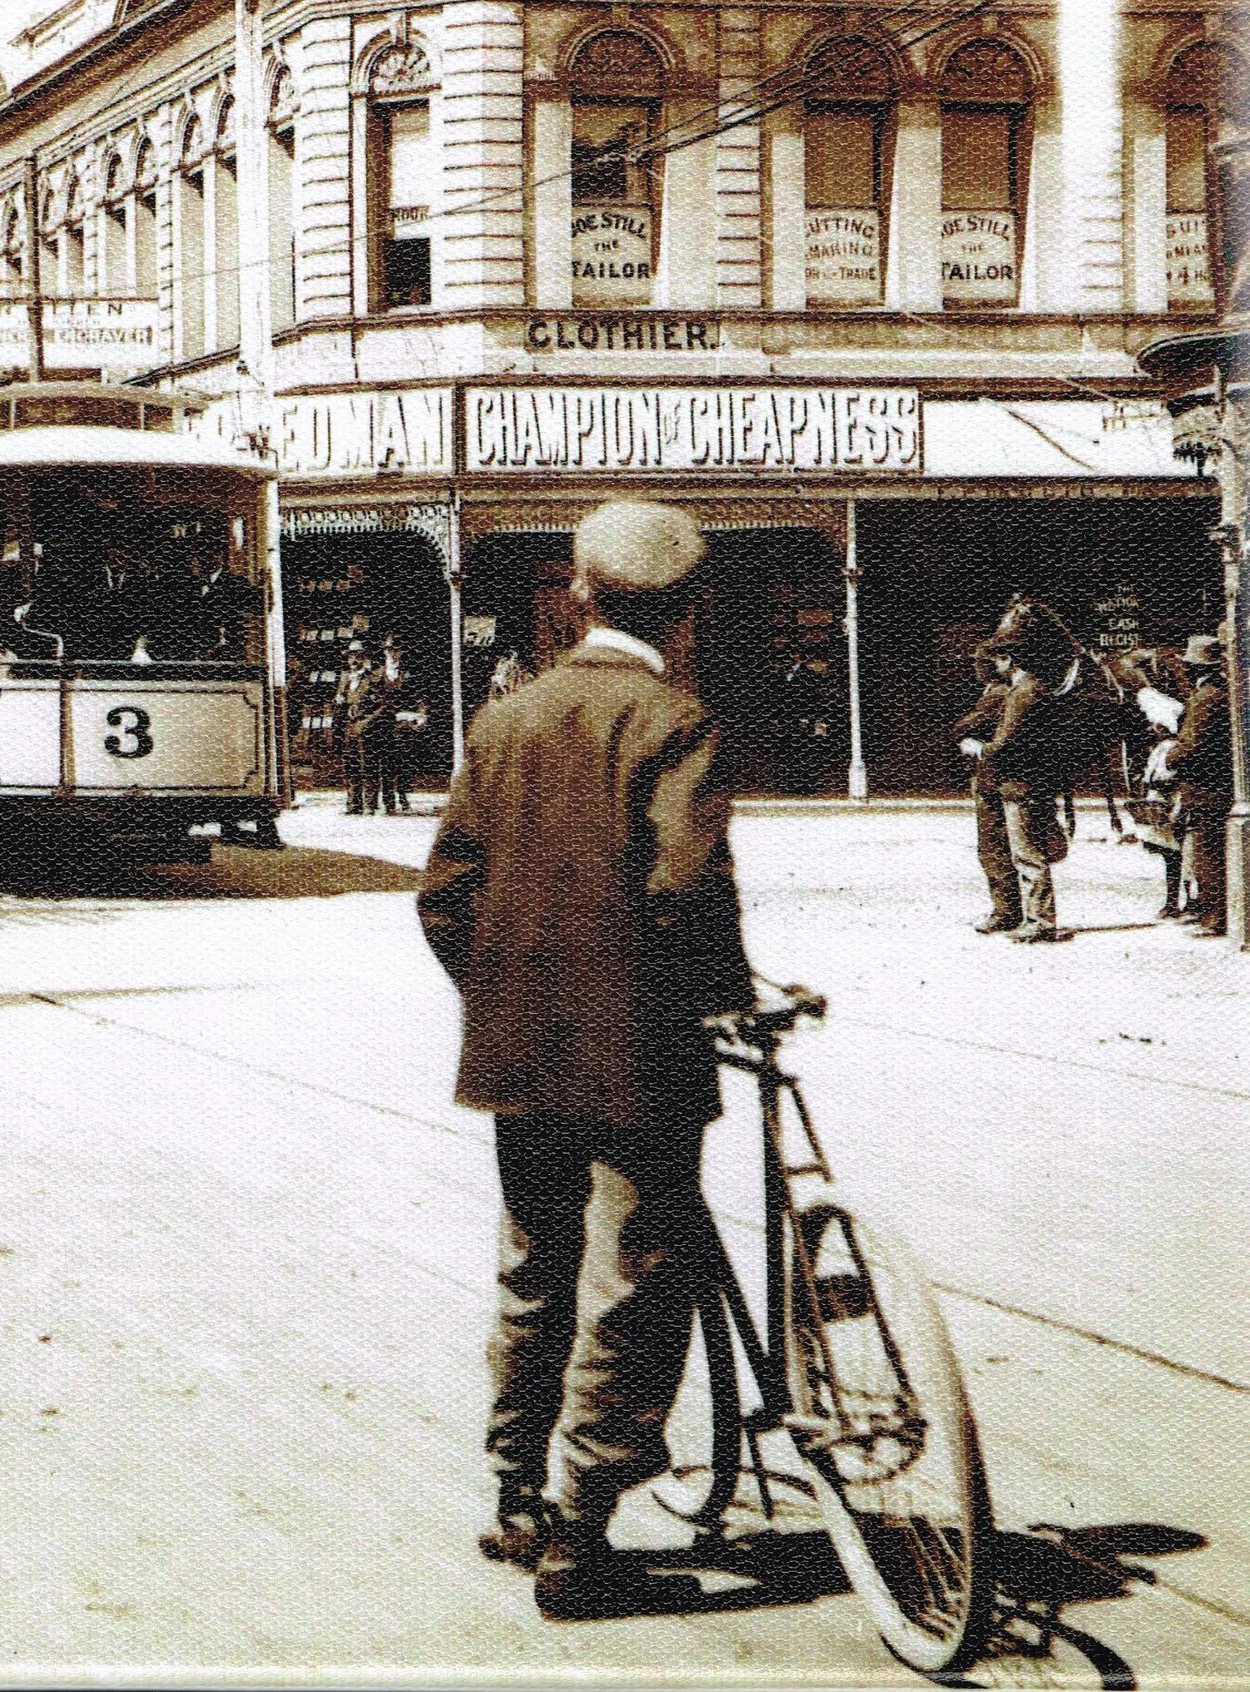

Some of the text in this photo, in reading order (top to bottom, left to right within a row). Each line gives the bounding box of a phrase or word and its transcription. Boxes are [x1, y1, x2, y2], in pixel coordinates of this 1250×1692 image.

[600, 211, 646, 240] STILL
[805, 217, 875, 239] UTTING
[966, 214, 1010, 242] STILL
[571, 260, 650, 279] TAILOR
[941, 261, 1014, 281] TAILOR
[477, 391, 663, 467] CHAMPION
[688, 391, 920, 466] CHEAPNESS
[103, 705, 154, 759] 3
